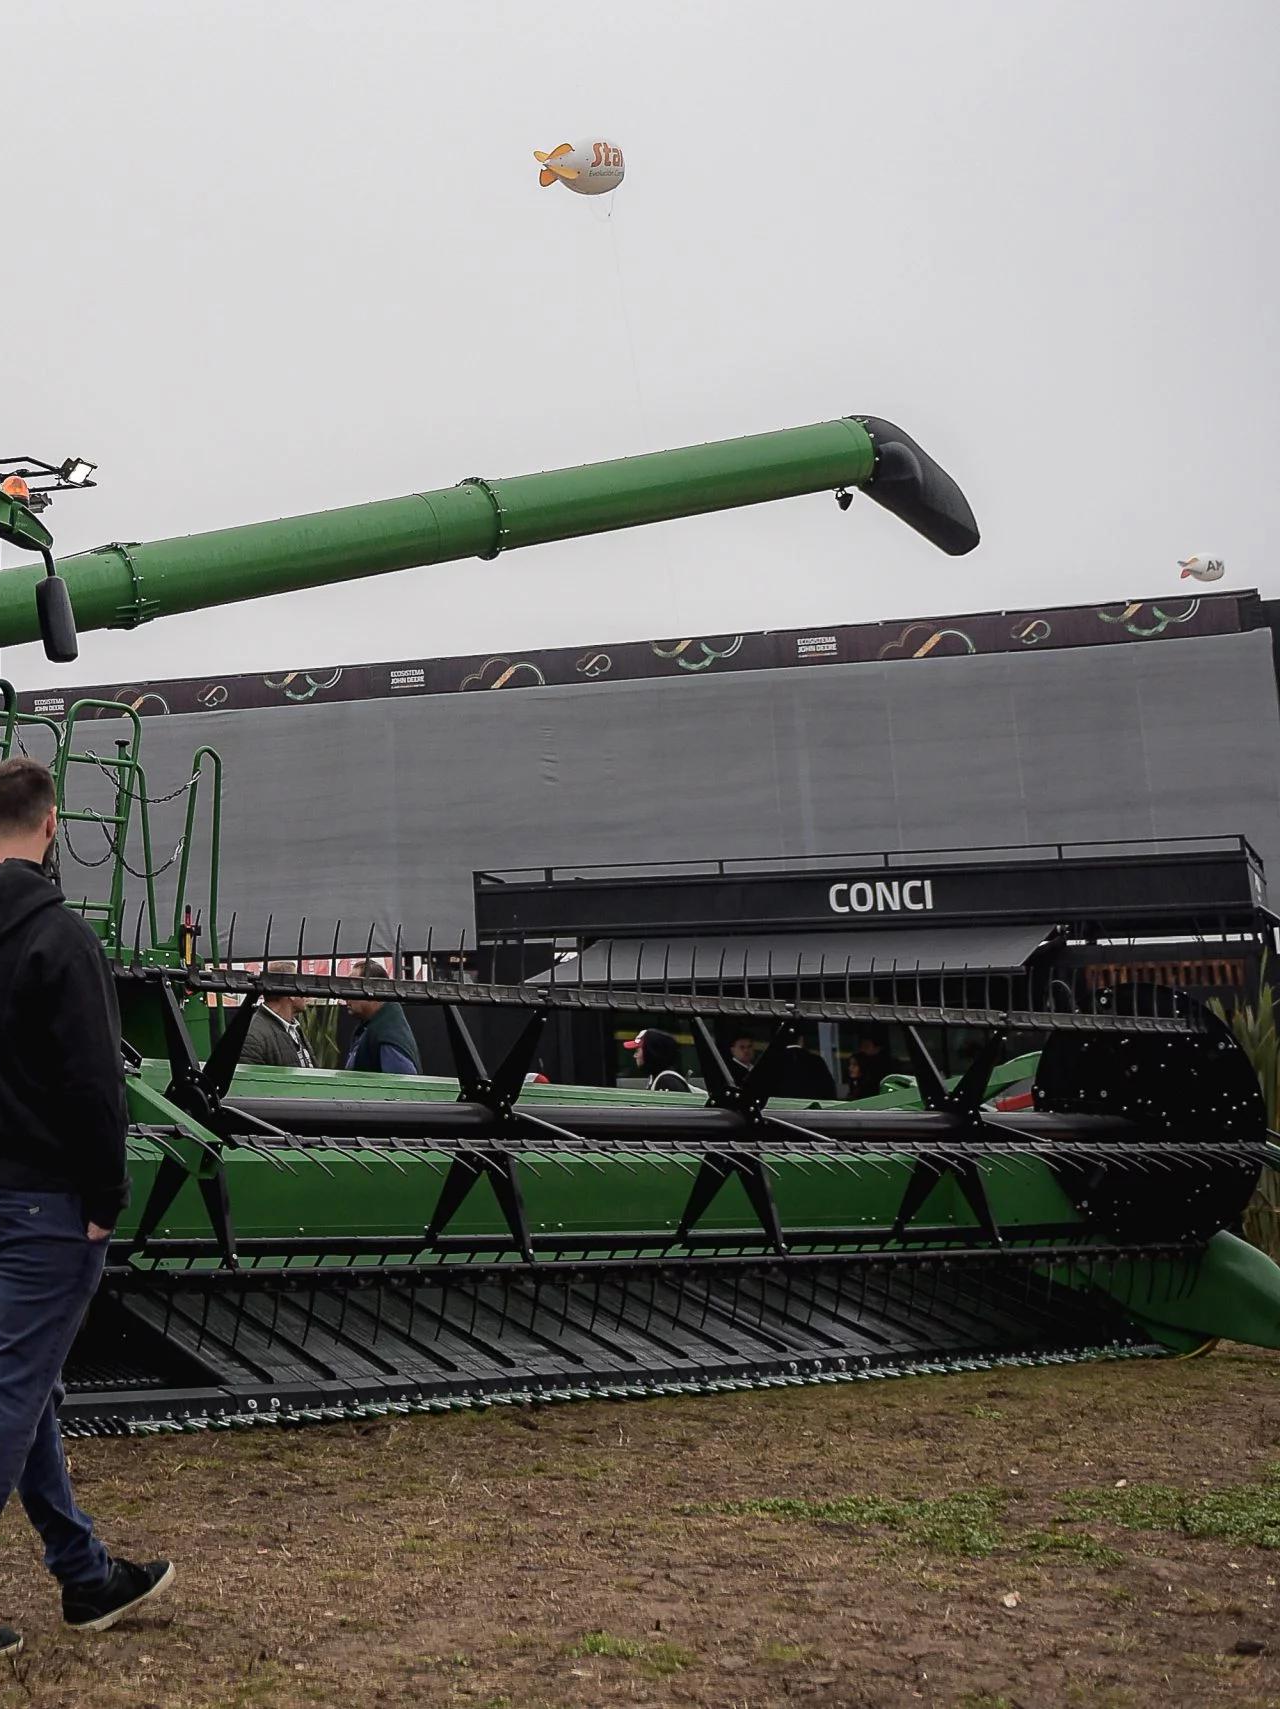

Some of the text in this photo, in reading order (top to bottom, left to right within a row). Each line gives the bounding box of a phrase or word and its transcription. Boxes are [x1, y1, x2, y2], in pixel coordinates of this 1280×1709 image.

[797, 635, 837, 646] ECOSISTEMA
[797, 643, 838, 653] JOHN DEERE
[390, 668, 425, 678] ECOSISTEMA
[390, 675, 425, 685] JOHN DEERE
[829, 879, 933, 913] CONCI
